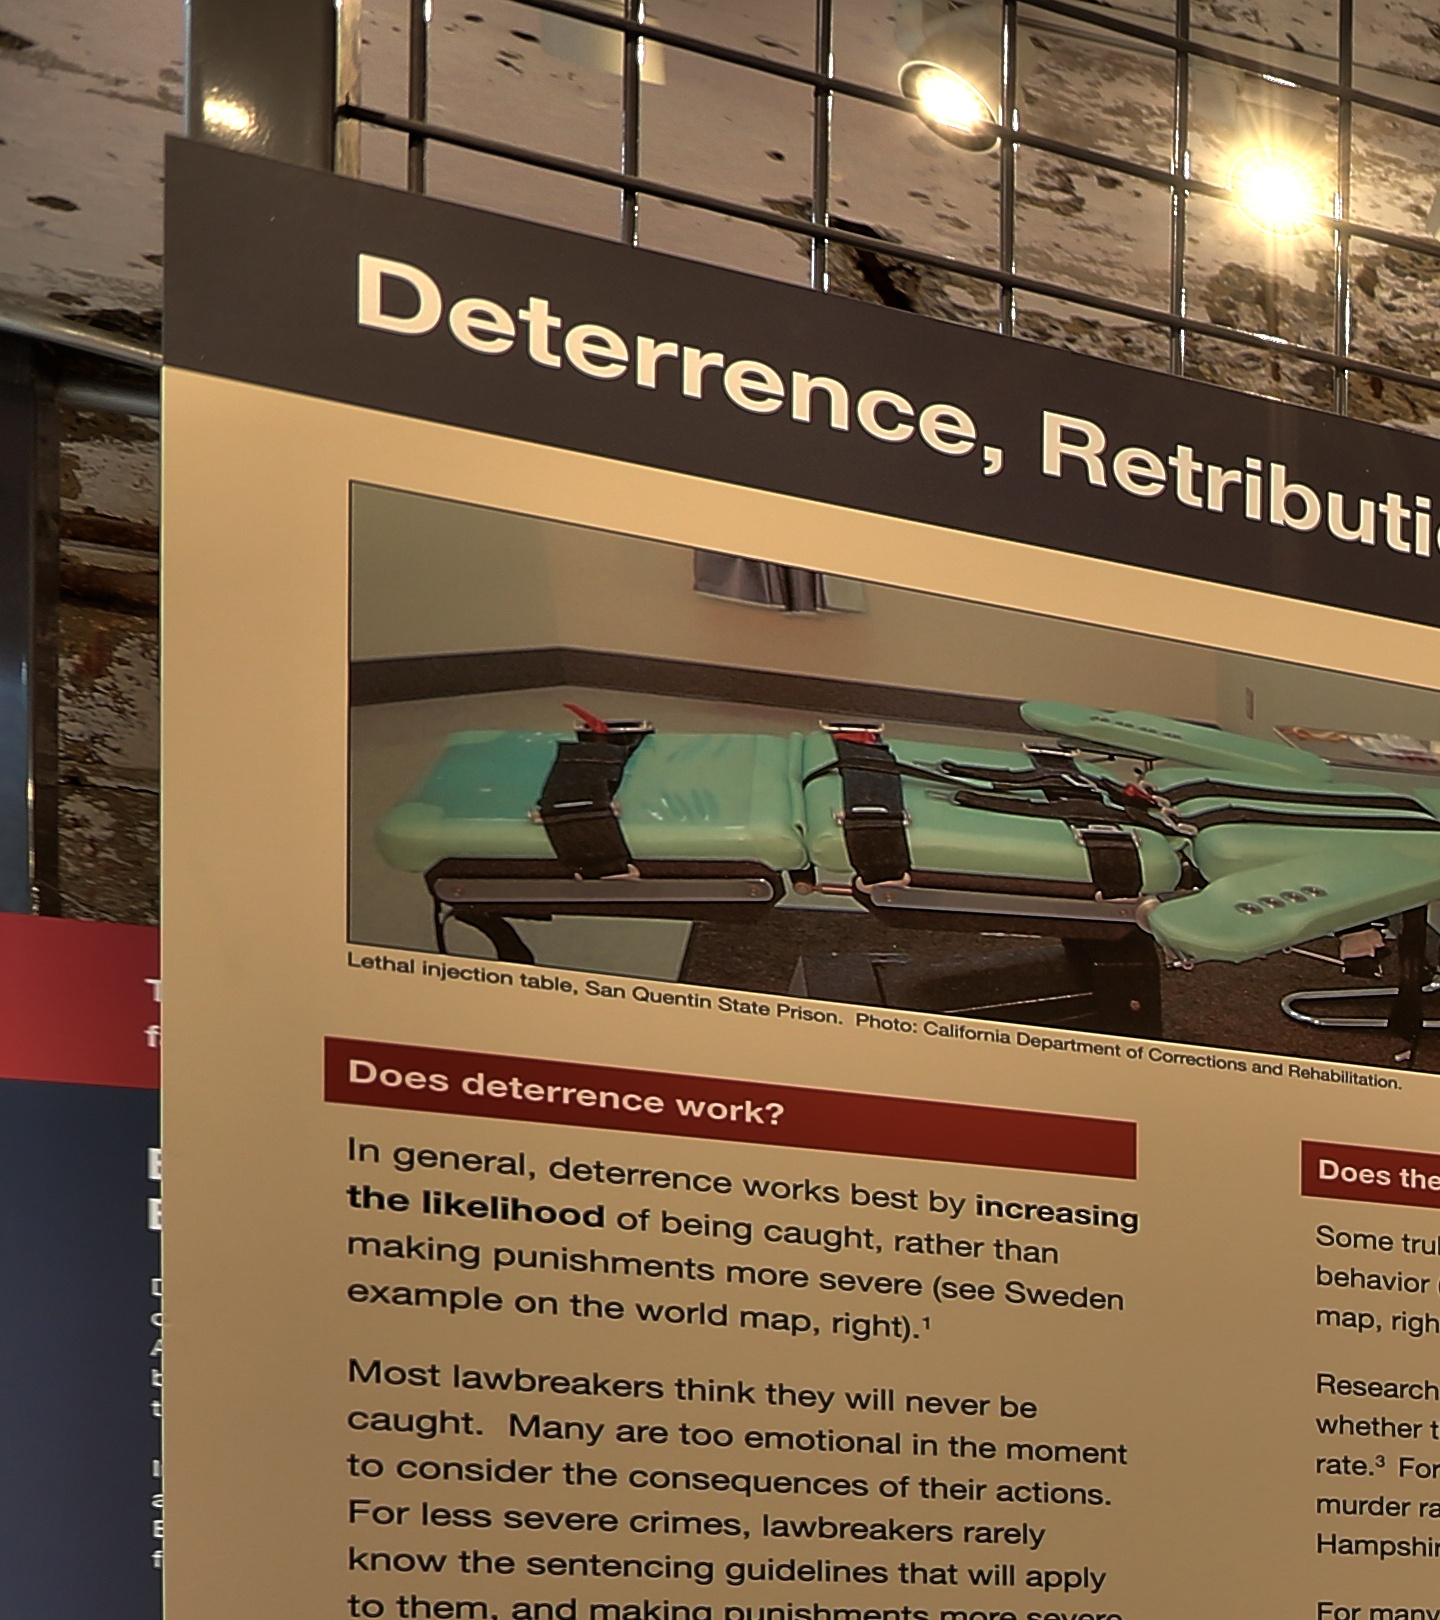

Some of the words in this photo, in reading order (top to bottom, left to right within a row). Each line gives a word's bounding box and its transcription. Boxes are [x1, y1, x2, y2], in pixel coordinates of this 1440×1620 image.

[359, 254, 1002, 474] Deterrence,
[348, 952, 414, 973] Lethal
[423, 961, 512, 985] injection
[520, 974, 577, 995] table,
[586, 981, 625, 998] San
[632, 986, 711, 1009] Quentin
[718, 997, 770, 1015] State
[777, 1003, 842, 1024] Prison.
[857, 1013, 917, 1033] Photo:
[924, 1021, 1011, 1044] California
[1017, 1032, 1120, 1057] Department
[1126, 1047, 1143, 1059] of
[1149, 1048, 1247, 1071] Corrections
[1252, 1063, 1282, 1075] and
[1289, 1064, 1401, 1090] Rehabilitation.
[350, 1060, 448, 1091] Does
[463, 1073, 664, 1113] deterrence
[676, 1099, 784, 1125] work?
[1320, 1160, 1390, 1185] Does
